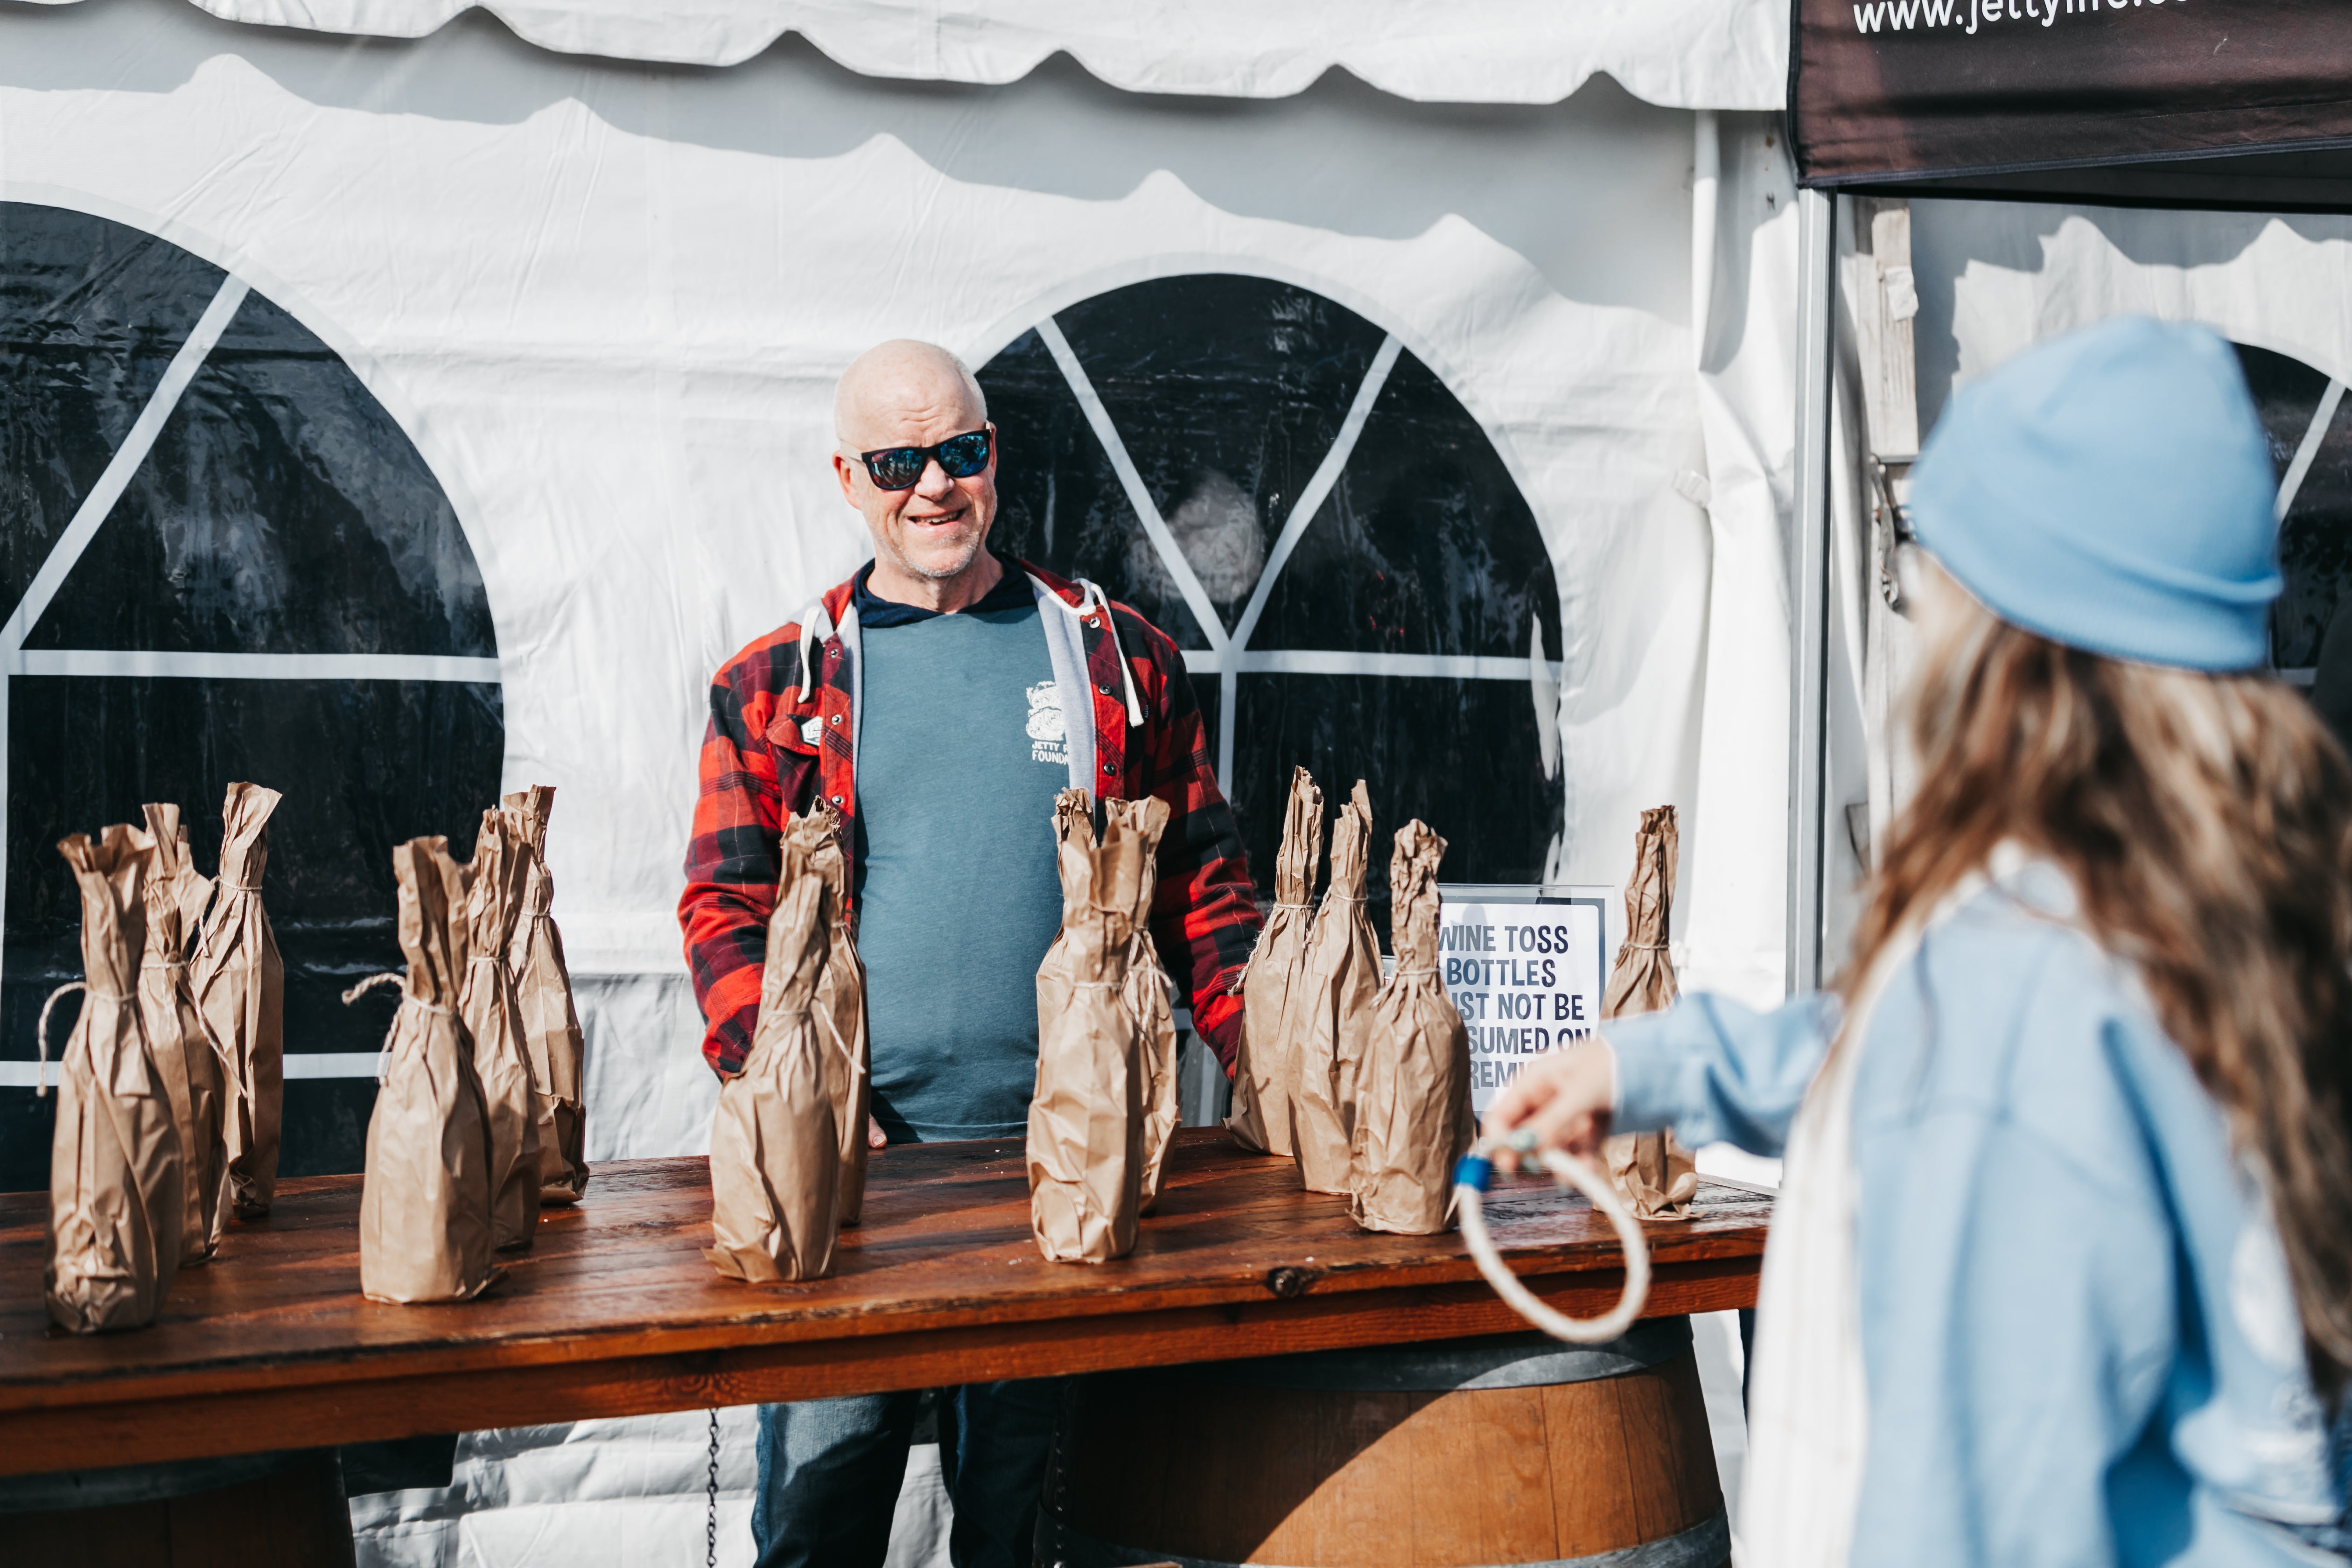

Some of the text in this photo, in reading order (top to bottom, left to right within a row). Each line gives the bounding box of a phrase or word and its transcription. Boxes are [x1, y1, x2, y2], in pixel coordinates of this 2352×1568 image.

[1032, 741, 1059, 751] JETTY
[1032, 749, 1069, 765] FOUNDA
[1439, 924, 1568, 954] WINE TOSS
[1447, 958, 1556, 987] BOTTLES
[1498, 993, 1546, 1020] NOT
[1554, 993, 1585, 1021] BE
[1467, 1026, 1549, 1055] SUMED
